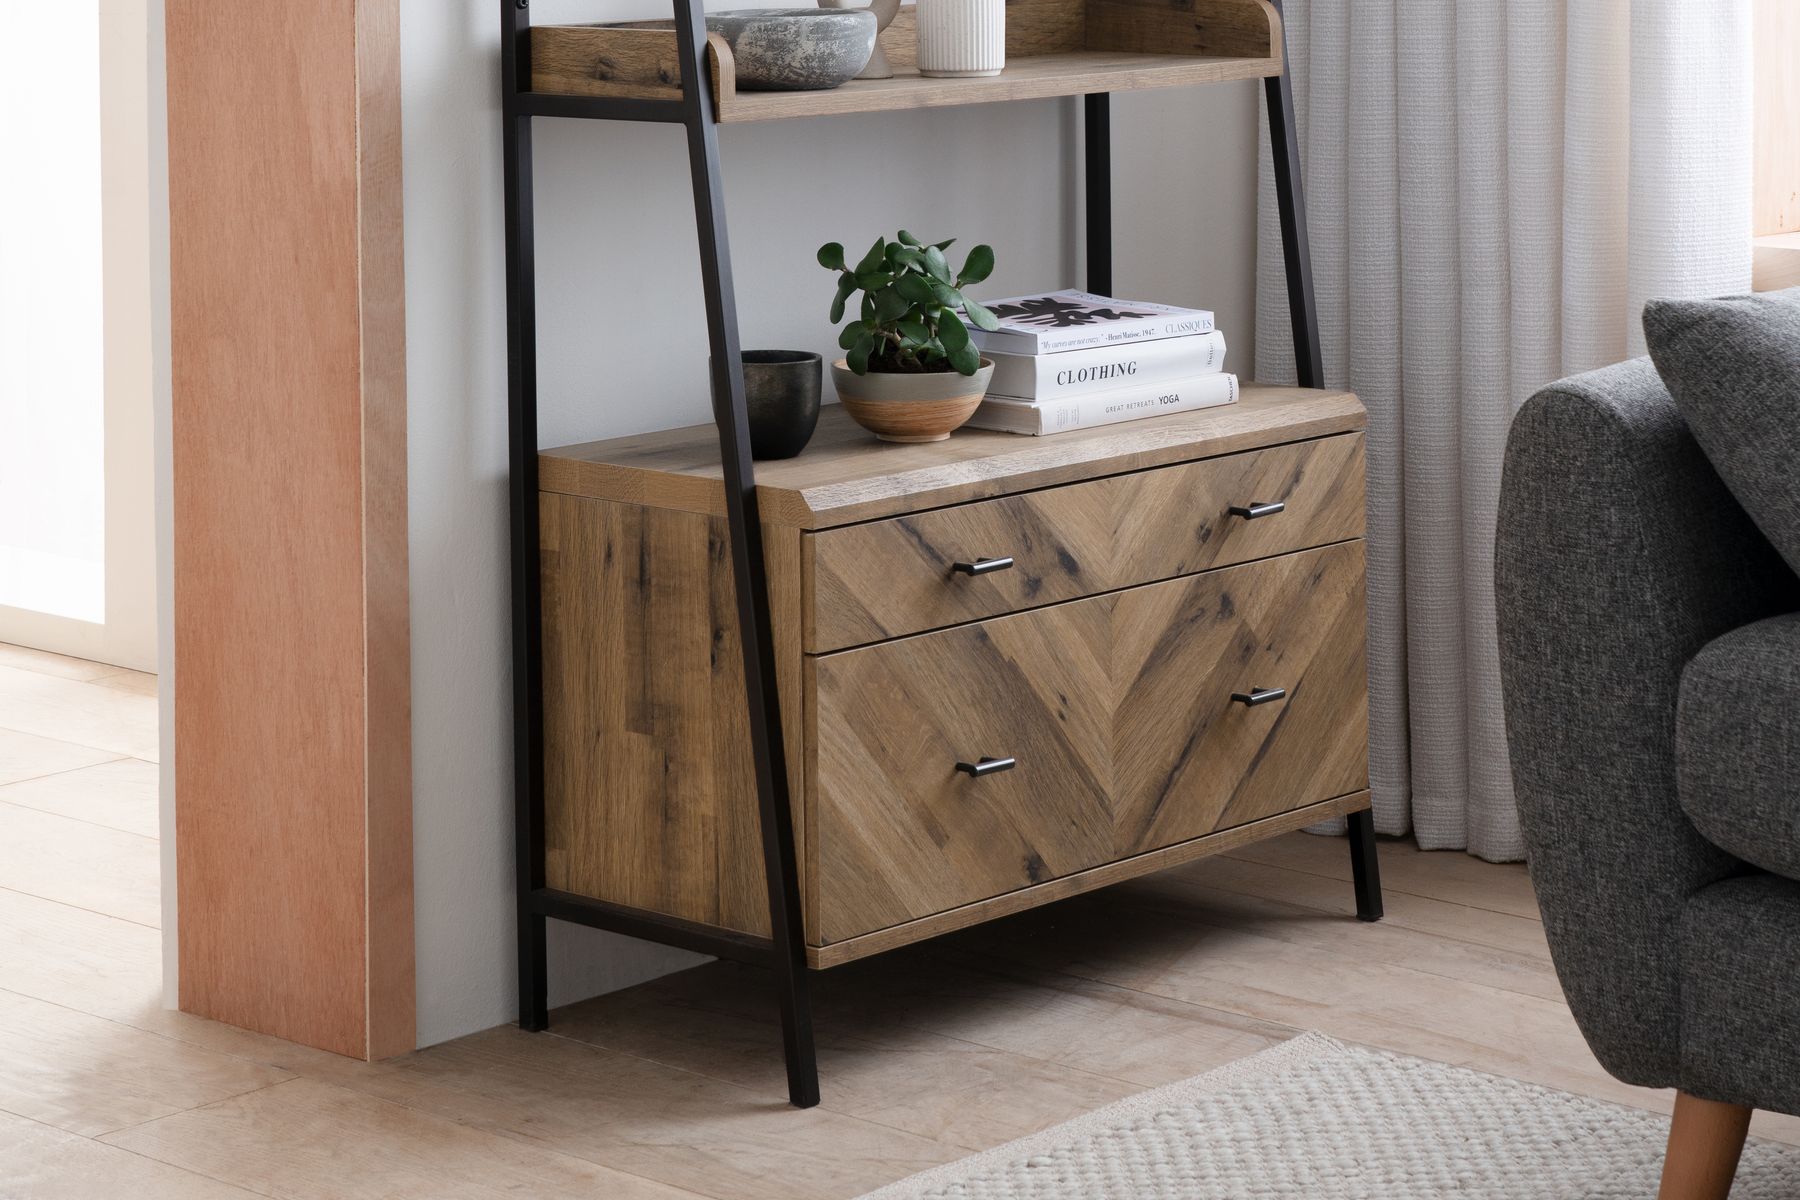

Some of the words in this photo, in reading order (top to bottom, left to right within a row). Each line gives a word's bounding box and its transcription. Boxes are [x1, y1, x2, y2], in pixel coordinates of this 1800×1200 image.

[1165, 319, 1213, 334] CLASSIQUES
[1056, 361, 1137, 386] CLOTHING
[1105, 404, 1124, 414] GREAT
[1126, 400, 1155, 410] RETREATS
[1158, 393, 1180, 405] YOGA
